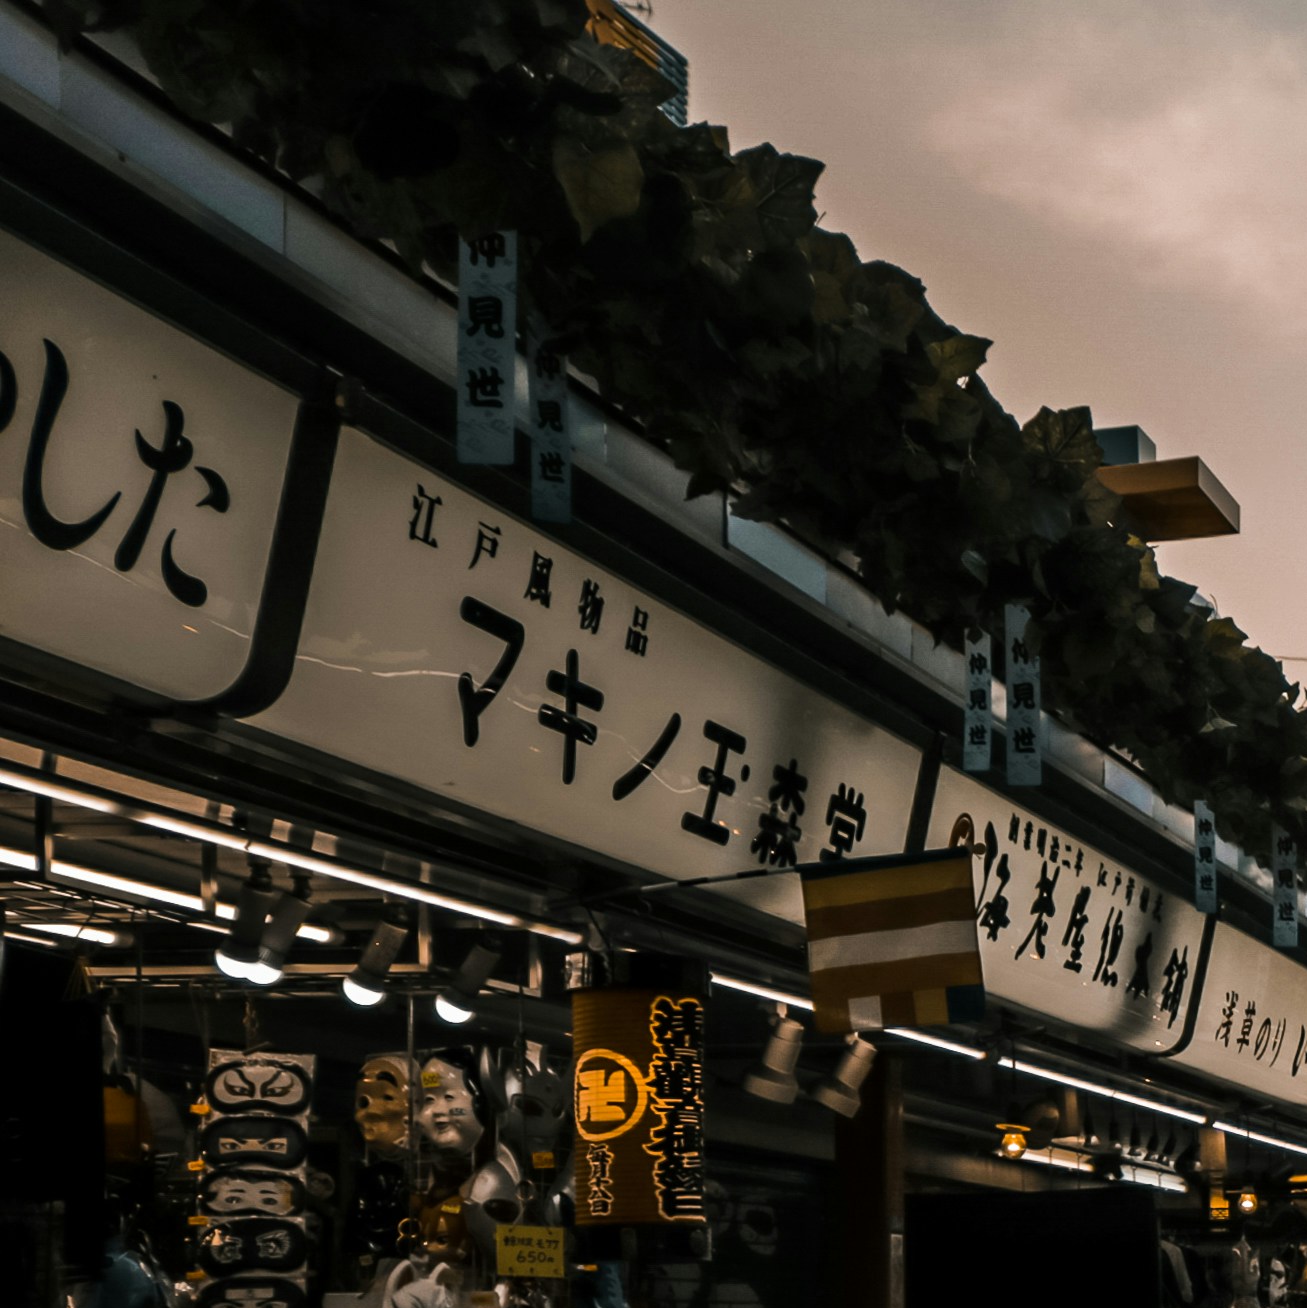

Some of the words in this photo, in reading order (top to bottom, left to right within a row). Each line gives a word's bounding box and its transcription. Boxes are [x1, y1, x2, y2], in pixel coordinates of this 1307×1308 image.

[409, 483, 650, 659] 江戸風物品
[458, 595, 868, 868] マキノ玉森堂
[967, 652, 989, 748] 仲見世
[1215, 990, 1287, 1067] 浅草のり
